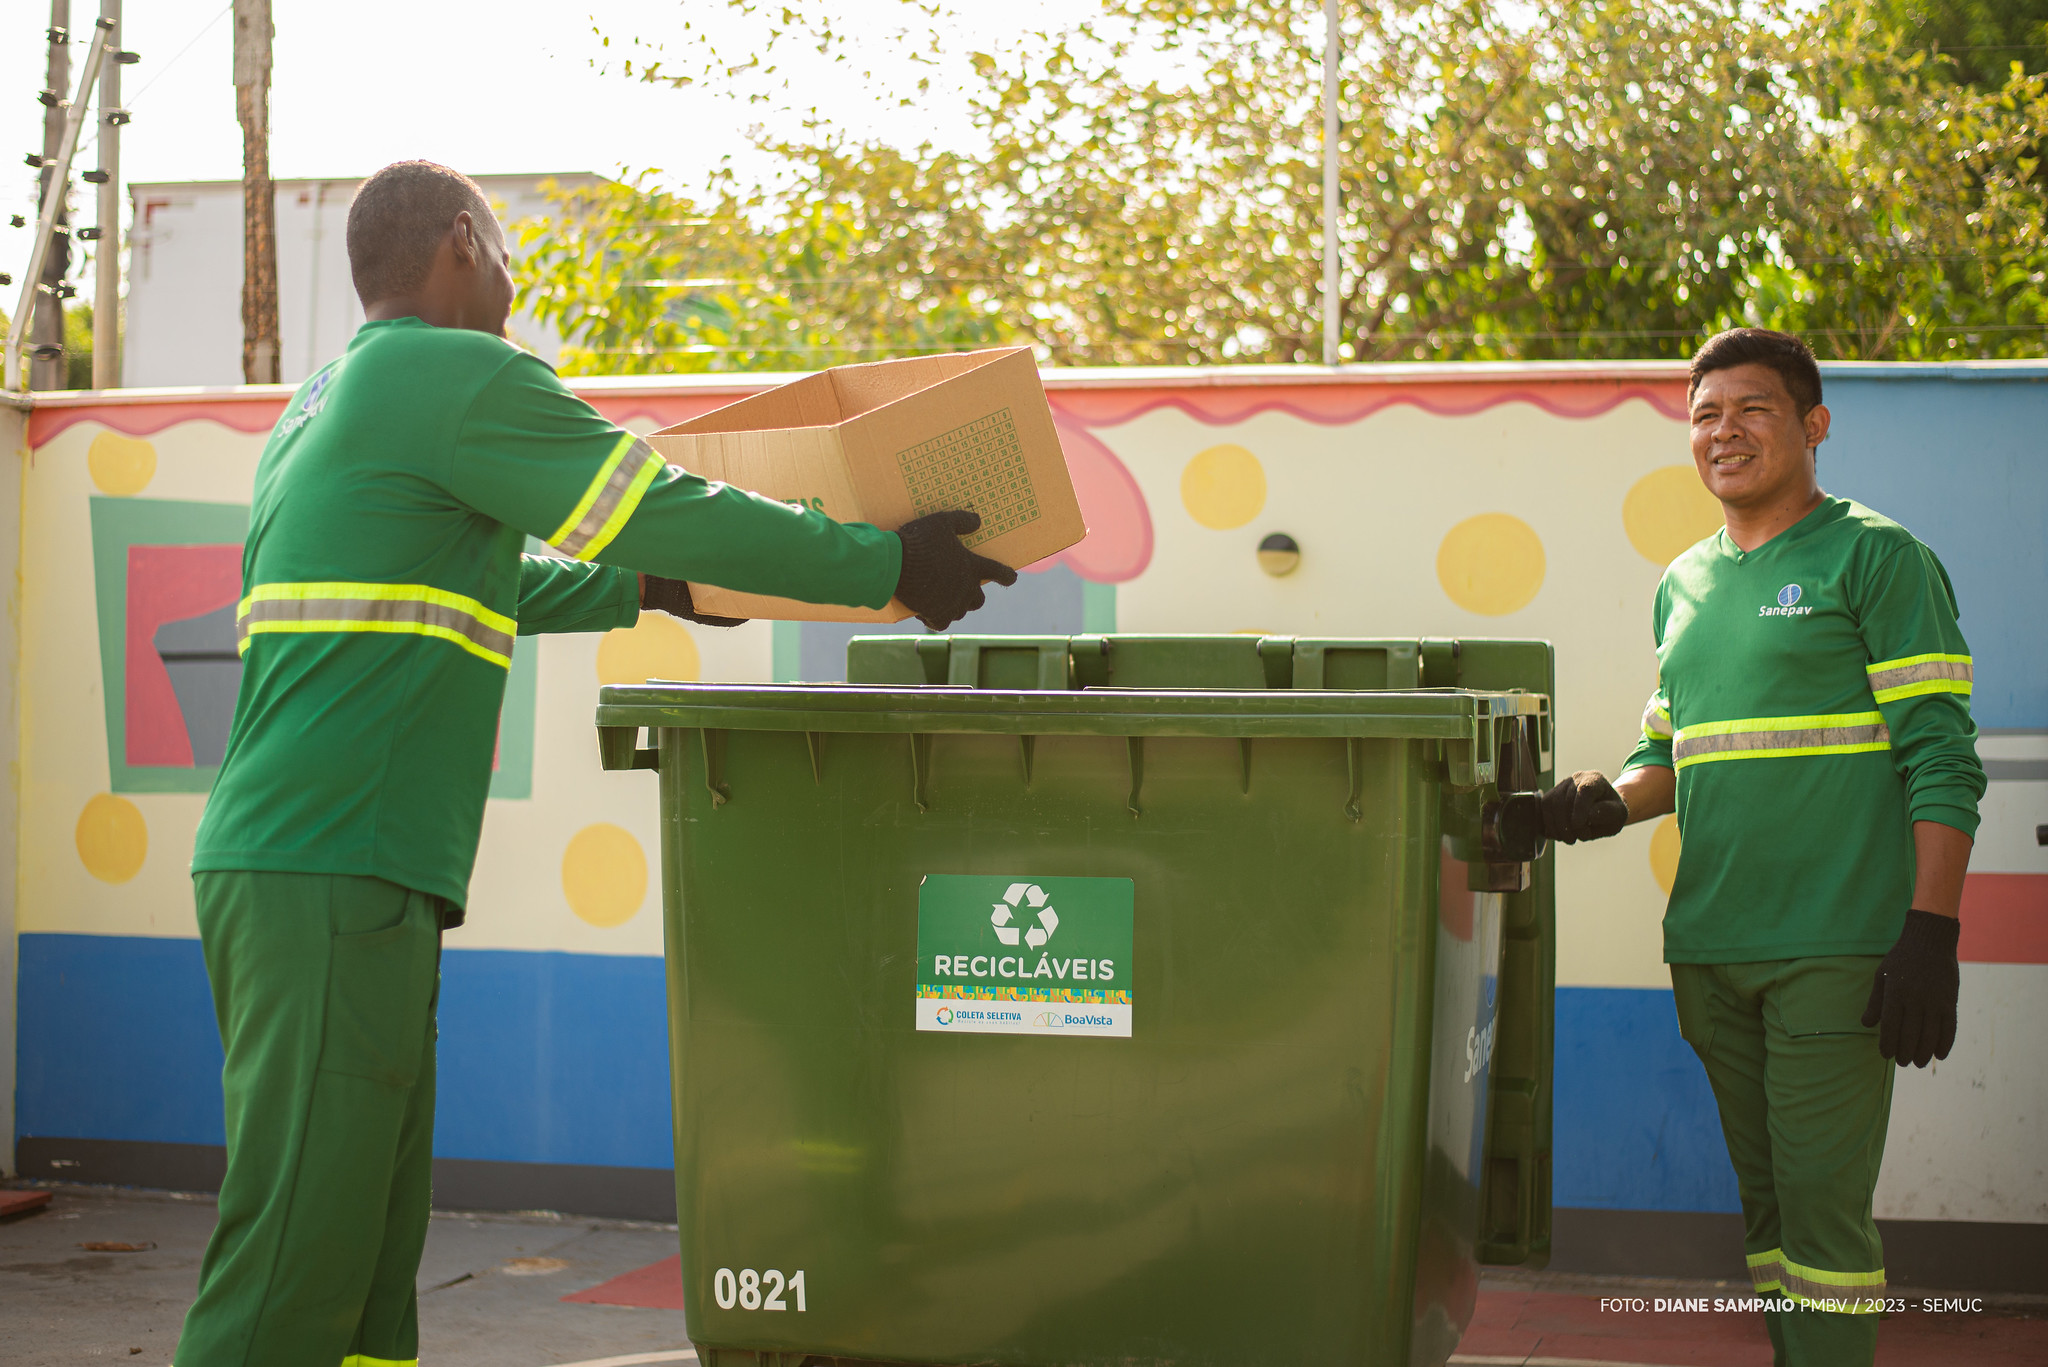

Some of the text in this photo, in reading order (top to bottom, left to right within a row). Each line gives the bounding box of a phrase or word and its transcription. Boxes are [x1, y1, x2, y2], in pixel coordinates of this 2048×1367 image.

[913, 449, 919, 457] 1
[924, 444, 930, 452] 2
[958, 430, 963, 438] 5
[980, 420, 985, 428] 7
[992, 416, 996, 424] 8
[1758, 605, 1813, 618] Sanepav
[934, 951, 1115, 980] RECICLÁVEIS
[956, 1010, 1022, 1021] COLETA SELETIVA
[1065, 1014, 1113, 1026] BoaVista
[1464, 1016, 1497, 1084] Sane
[714, 1267, 807, 1312] 0821
